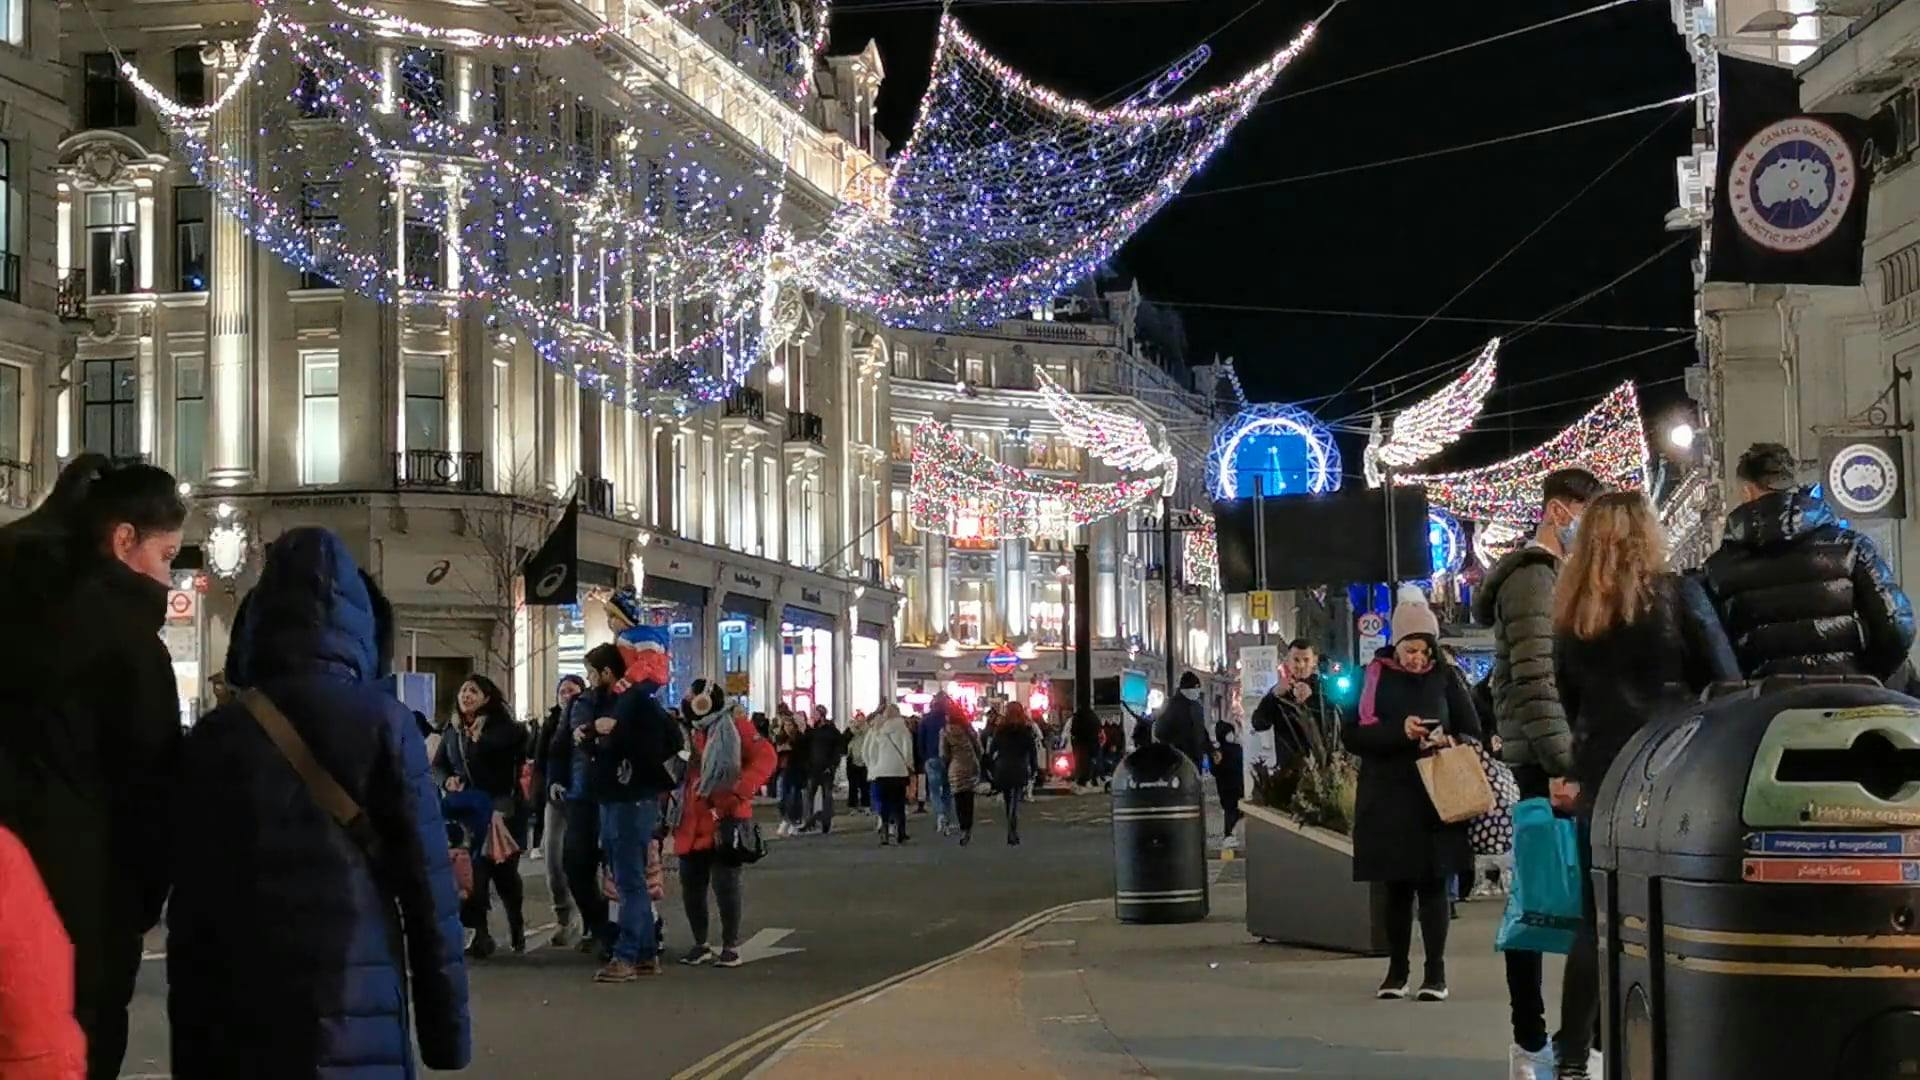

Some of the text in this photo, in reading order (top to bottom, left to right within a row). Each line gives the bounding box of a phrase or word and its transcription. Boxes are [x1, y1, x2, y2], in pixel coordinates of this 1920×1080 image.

[1760, 125, 1837, 148] CANADA GOOSE
[1362, 618, 1380, 631] 20
